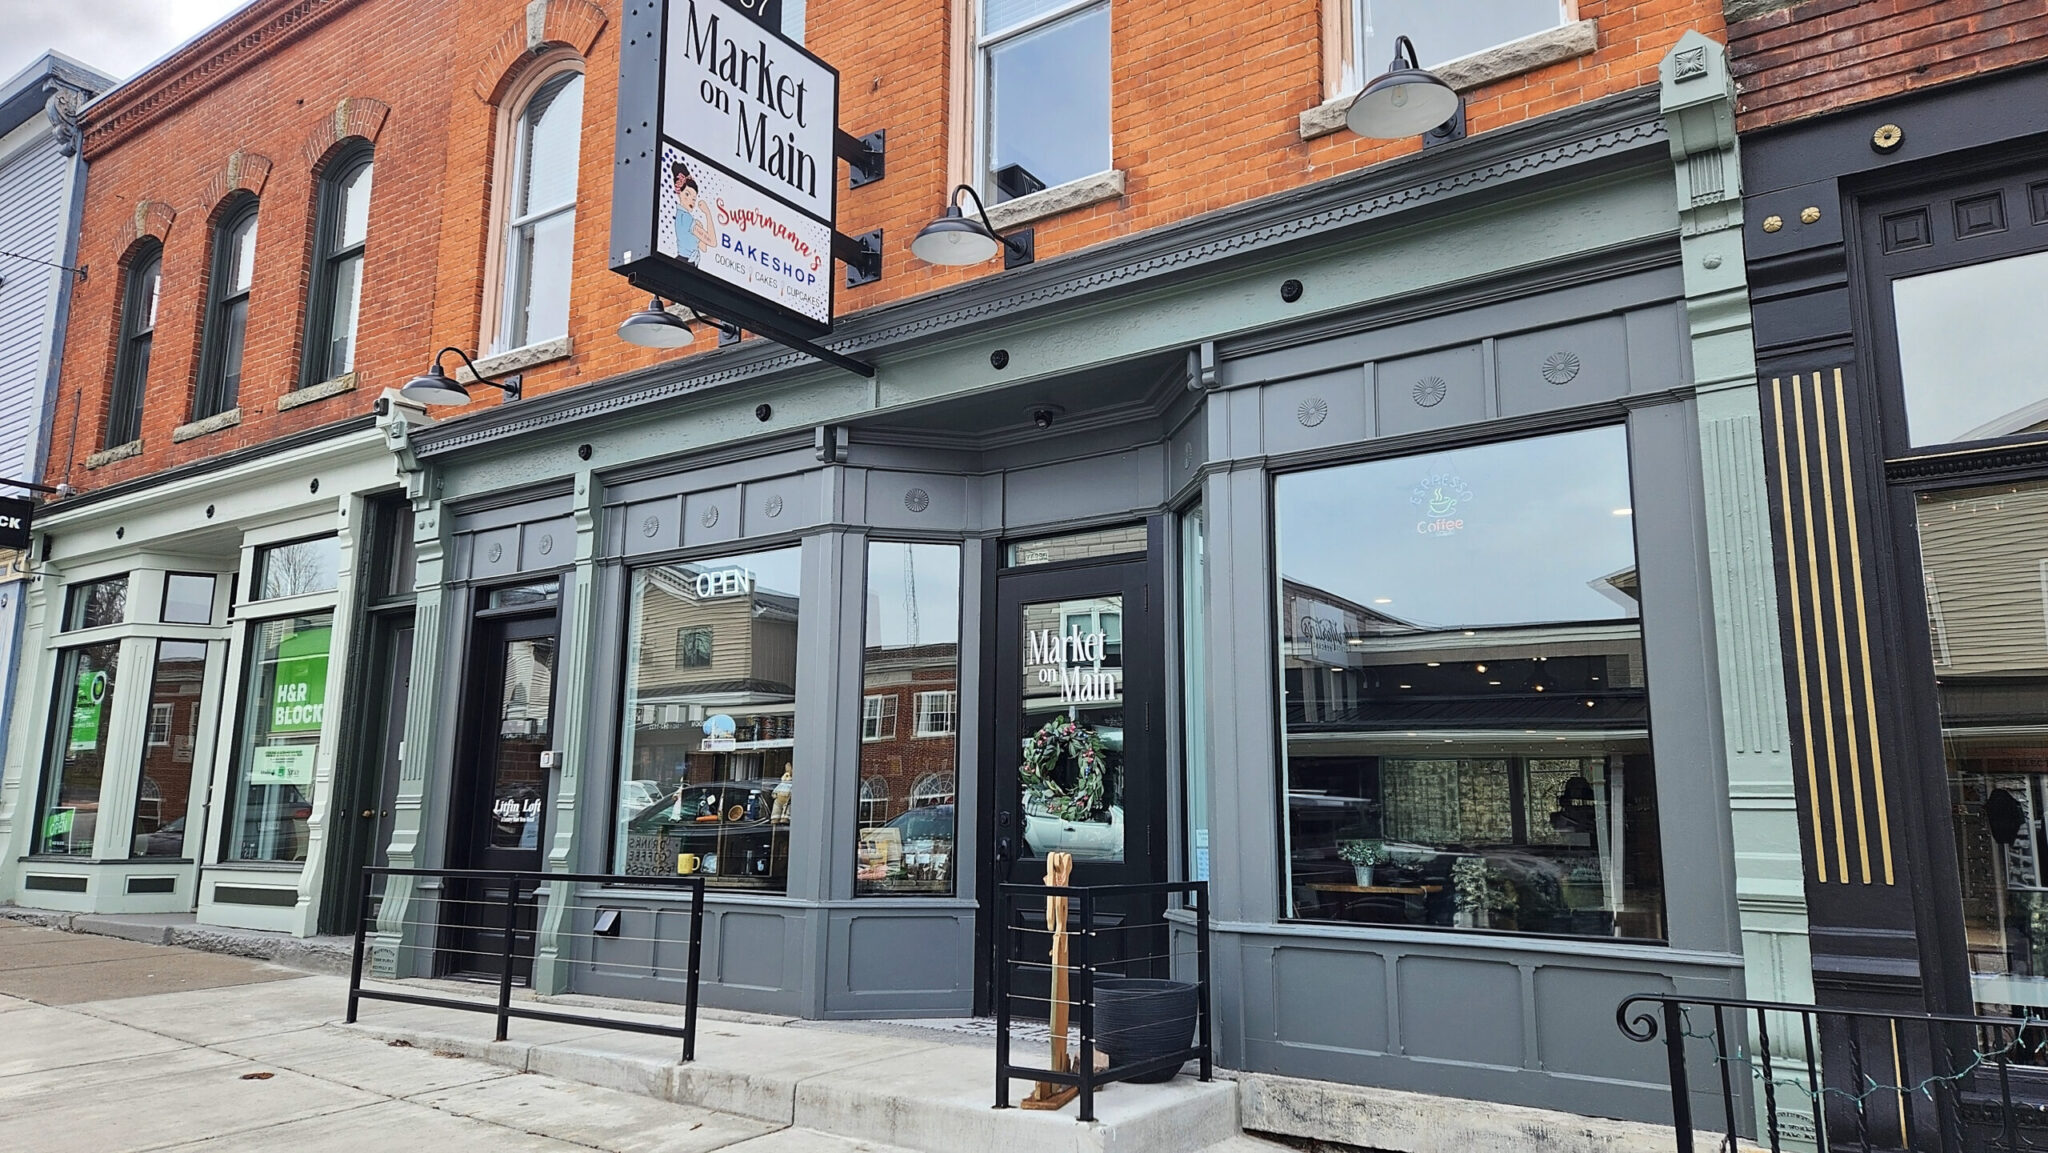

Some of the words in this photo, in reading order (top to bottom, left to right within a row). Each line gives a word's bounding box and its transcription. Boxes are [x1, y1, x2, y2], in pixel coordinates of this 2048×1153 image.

[684, 0, 808, 128] Market
[700, 79, 730, 115] on
[735, 98, 817, 198] Main
[716, 197, 822, 272] Sugarmama's
[721, 233, 816, 286] BAKESHOP
[714, 253, 746, 275] COOKIES
[755, 271, 778, 289] CAKES
[786, 285, 820, 308] CUPCAKES
[1409, 472, 1474, 505] ESPRESSO
[1416, 518, 1464, 534] Coffee
[696, 568, 750, 598] OPEN
[1029, 623, 1107, 665] Market
[277, 682, 307, 703] H&R
[1038, 668, 1057, 683] on
[1060, 665, 1116, 702] Main
[275, 703, 324, 726] BLOCK
[493, 799, 520, 817] Litfin
[522, 798, 542, 817] Loft
